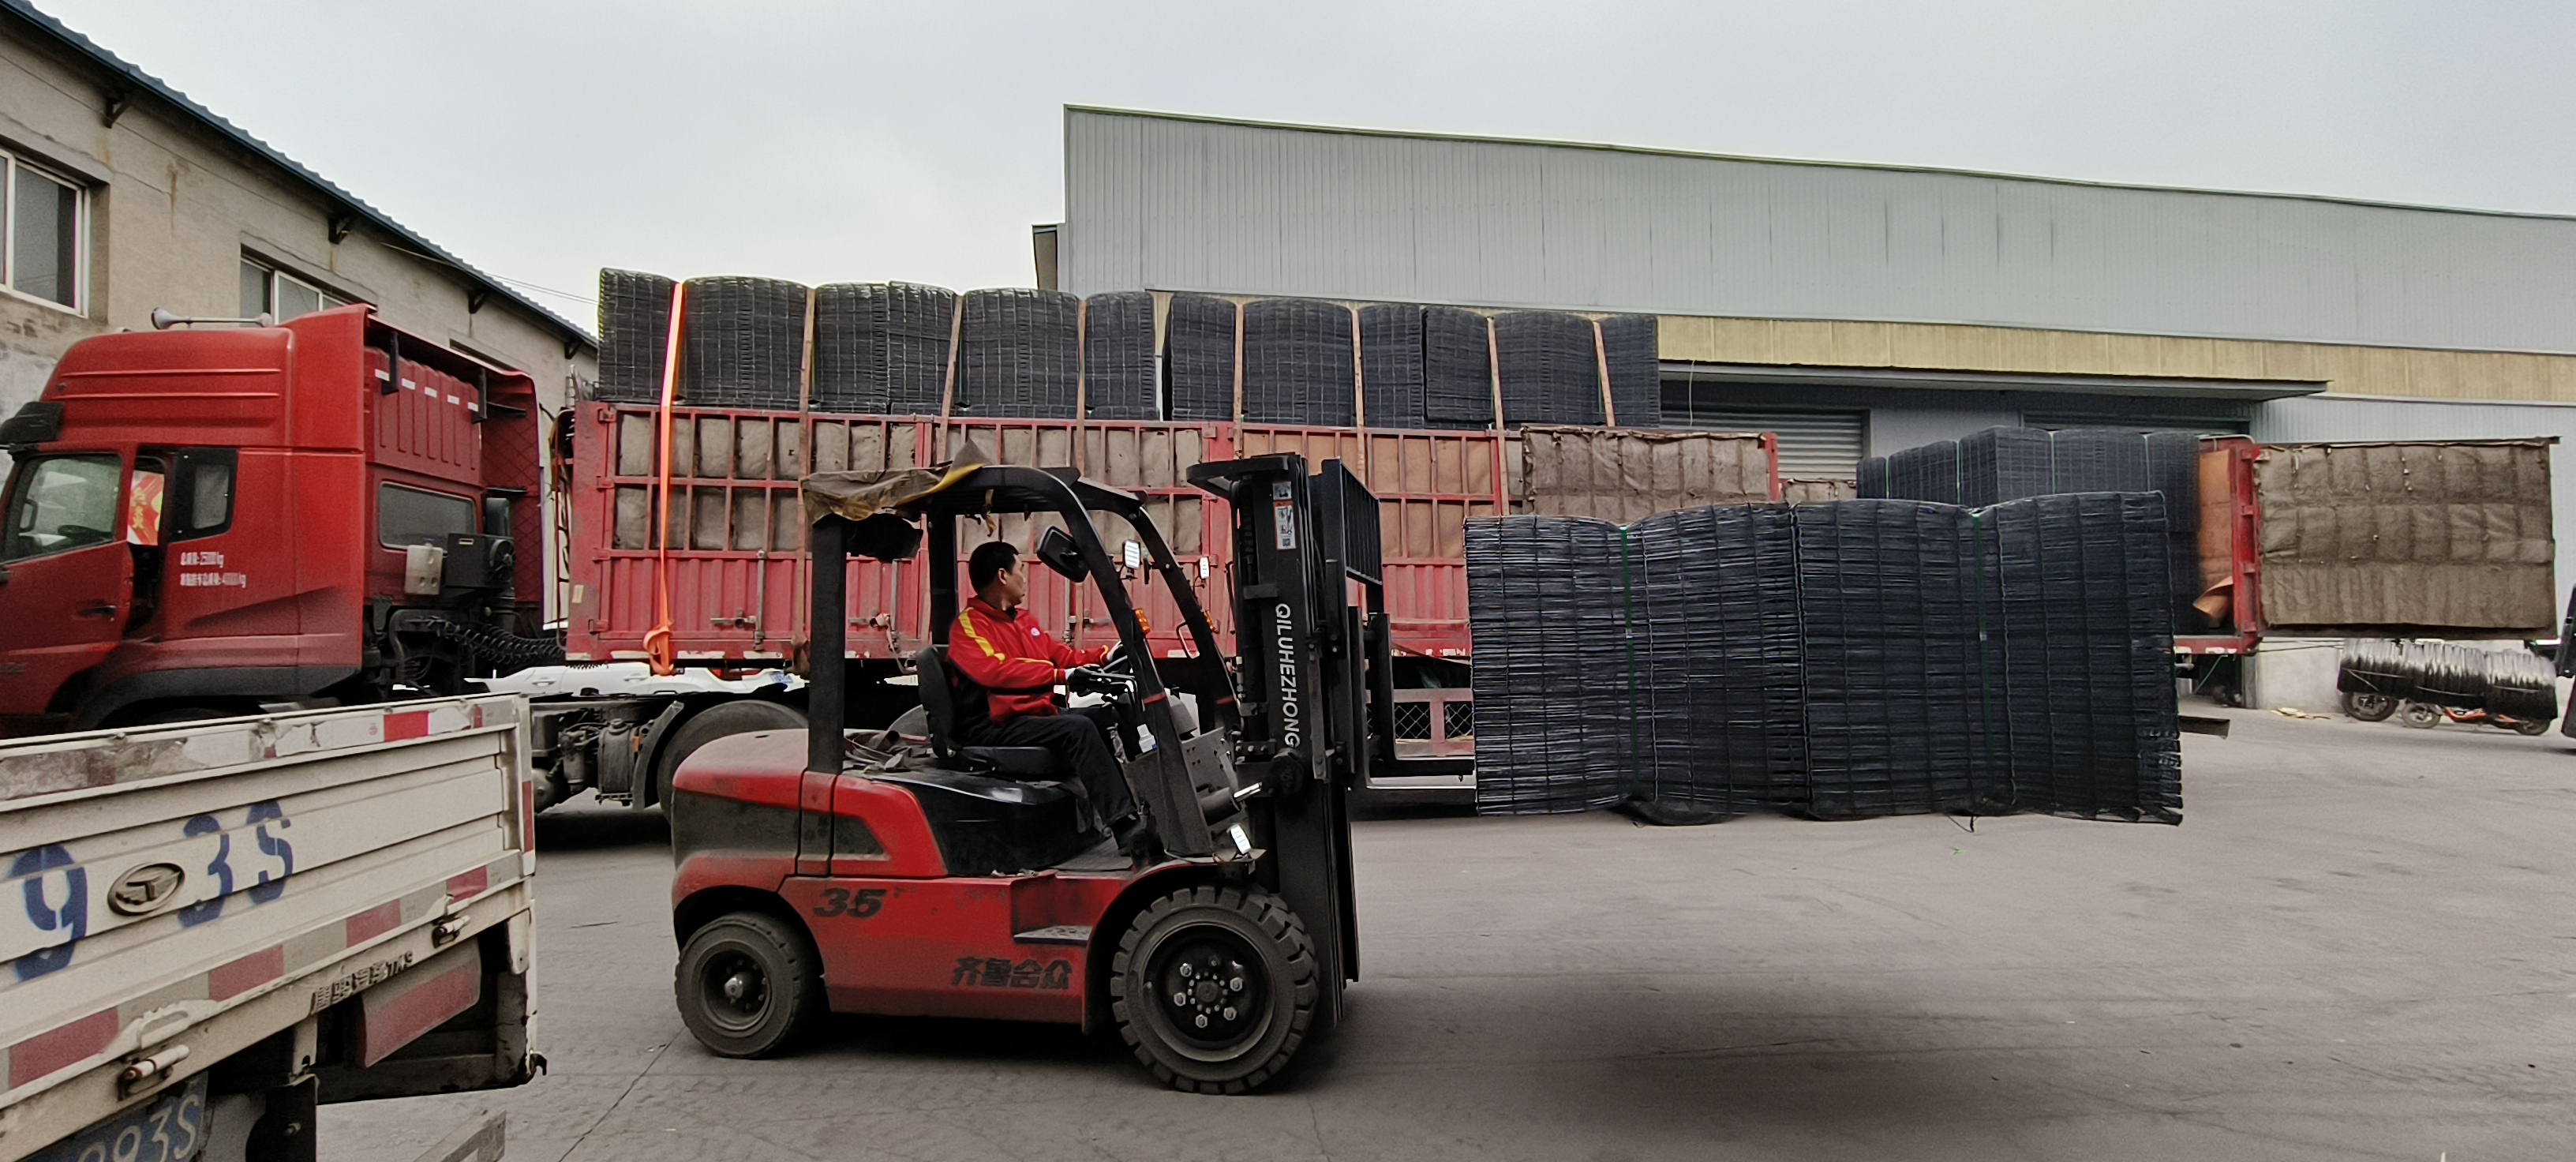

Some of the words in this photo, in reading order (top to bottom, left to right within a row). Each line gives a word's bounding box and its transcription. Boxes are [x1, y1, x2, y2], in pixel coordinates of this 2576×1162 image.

[1275, 603, 1301, 748] QILUHEZHONG
[813, 887, 887, 919] 35
[952, 956, 1072, 989] 齐鲁合众
